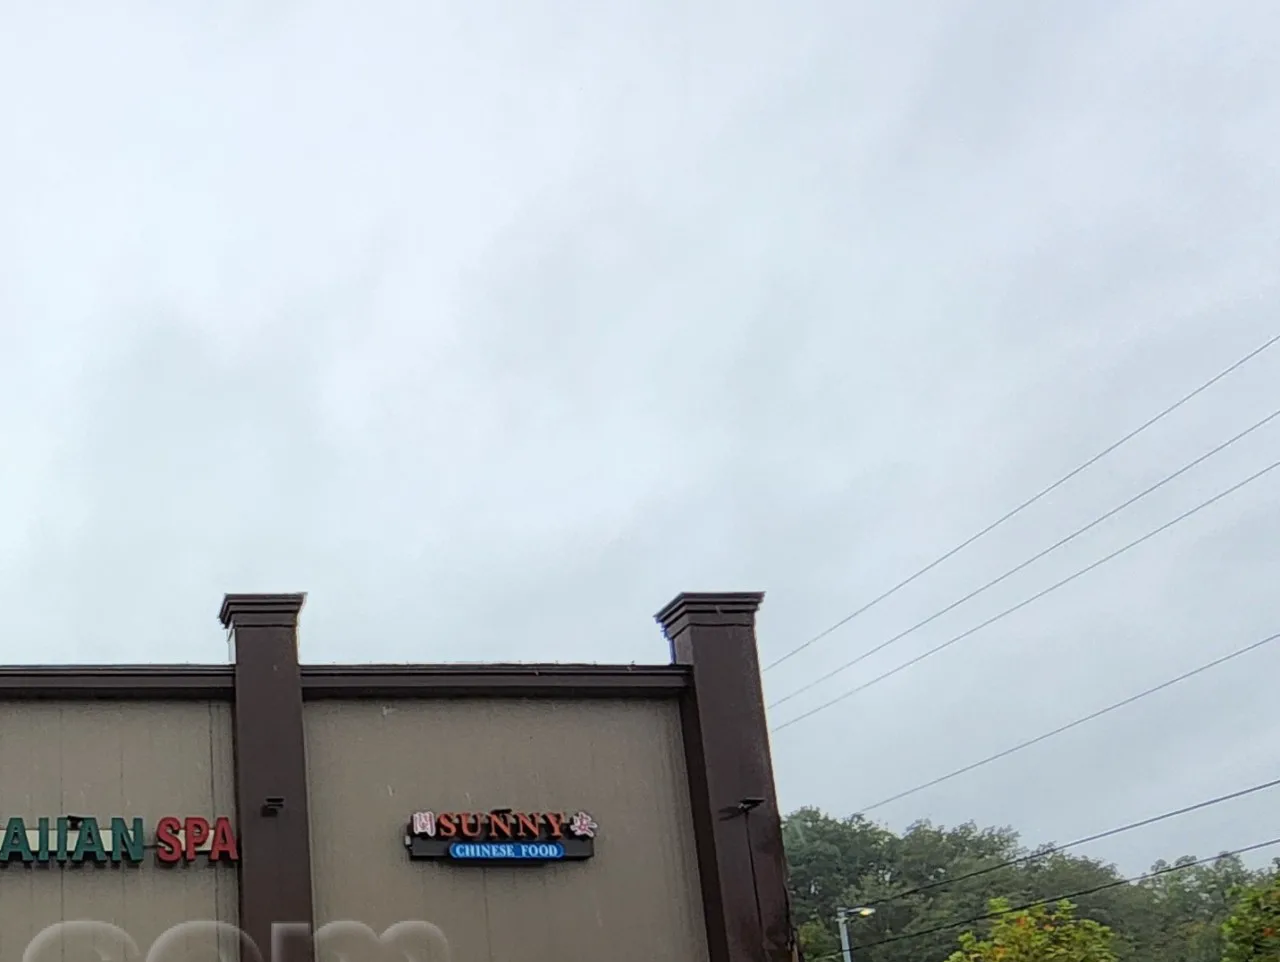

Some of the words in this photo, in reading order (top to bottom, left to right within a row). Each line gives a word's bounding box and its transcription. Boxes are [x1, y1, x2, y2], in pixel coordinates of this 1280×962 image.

[437, 812, 565, 838] SUNNY
[156, 816, 239, 862] SPA
[454, 843, 515, 857] CHINESE
[521, 843, 559, 857] FOOD
